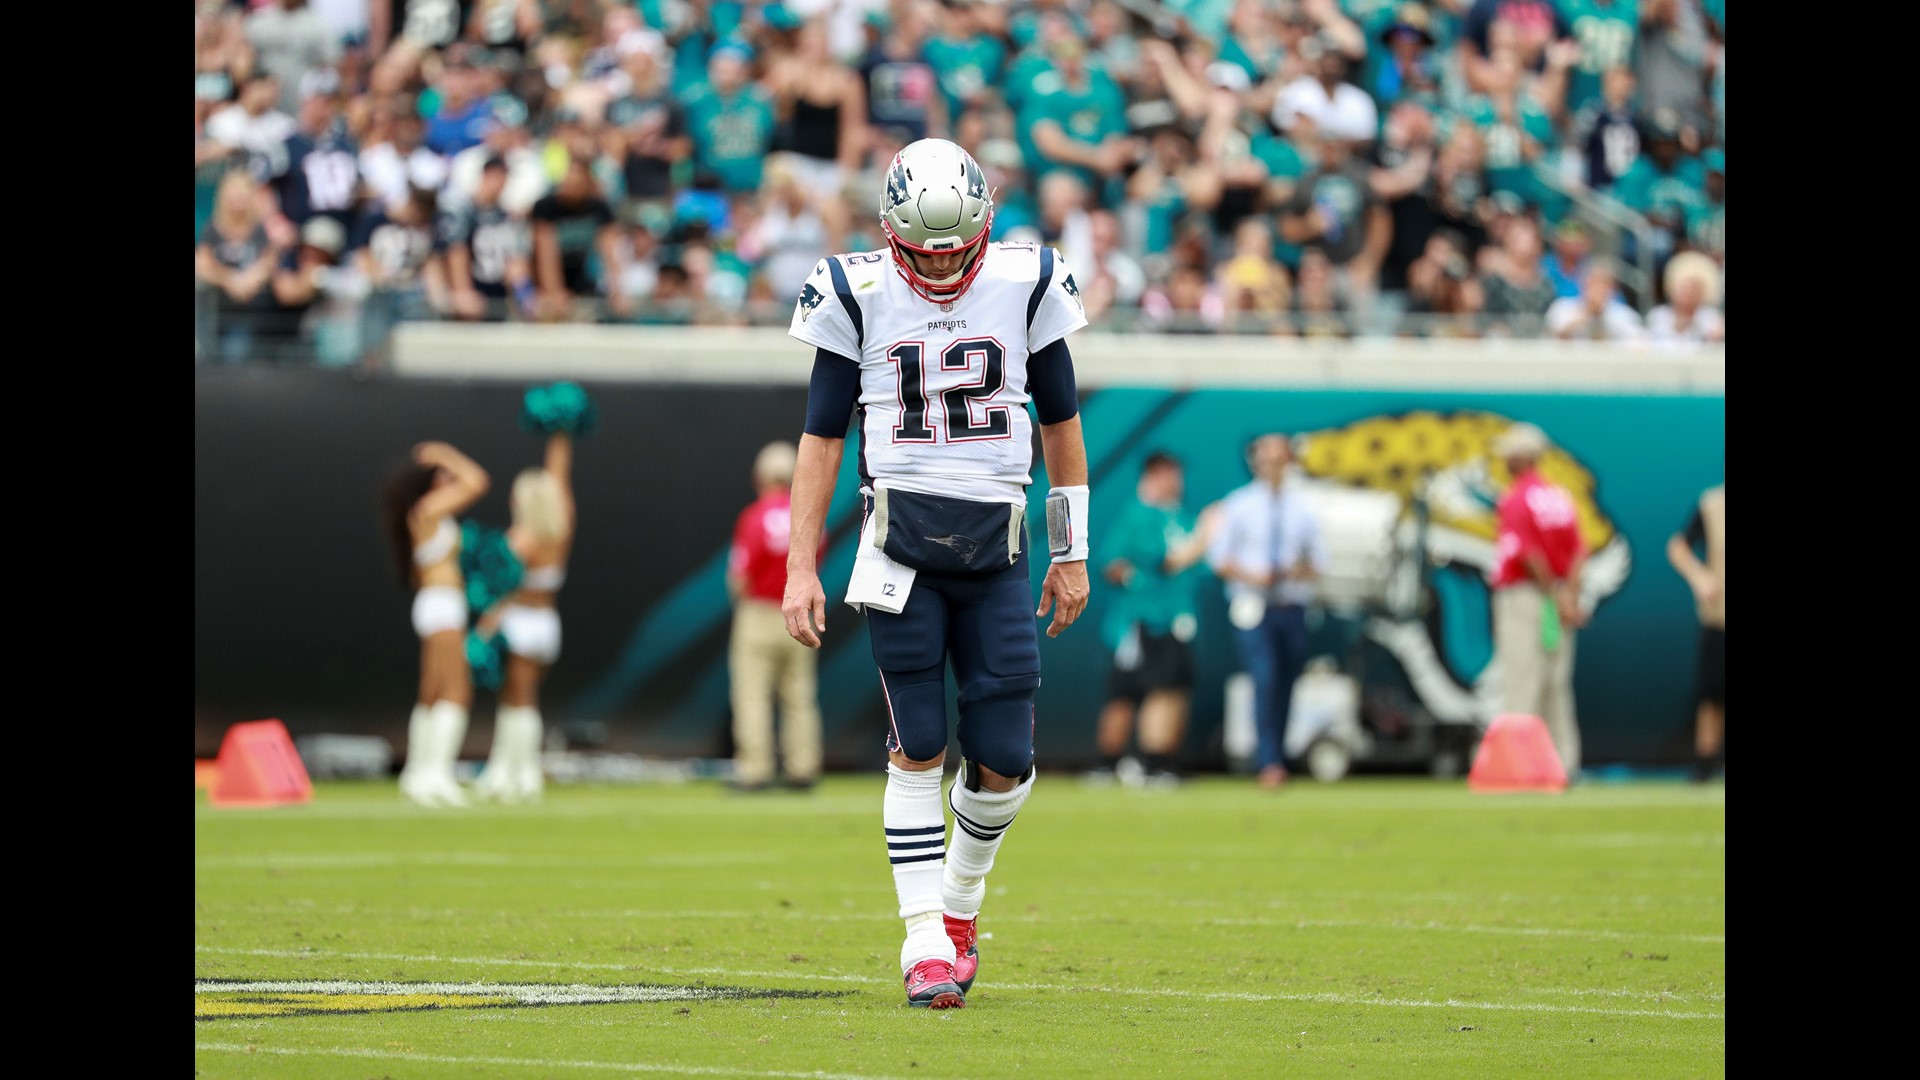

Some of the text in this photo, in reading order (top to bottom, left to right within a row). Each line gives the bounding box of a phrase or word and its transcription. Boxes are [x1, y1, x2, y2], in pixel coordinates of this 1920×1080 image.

[927, 320, 967, 331] PATRIOTS
[887, 336, 1011, 443] 12
[881, 582, 896, 597] 12
